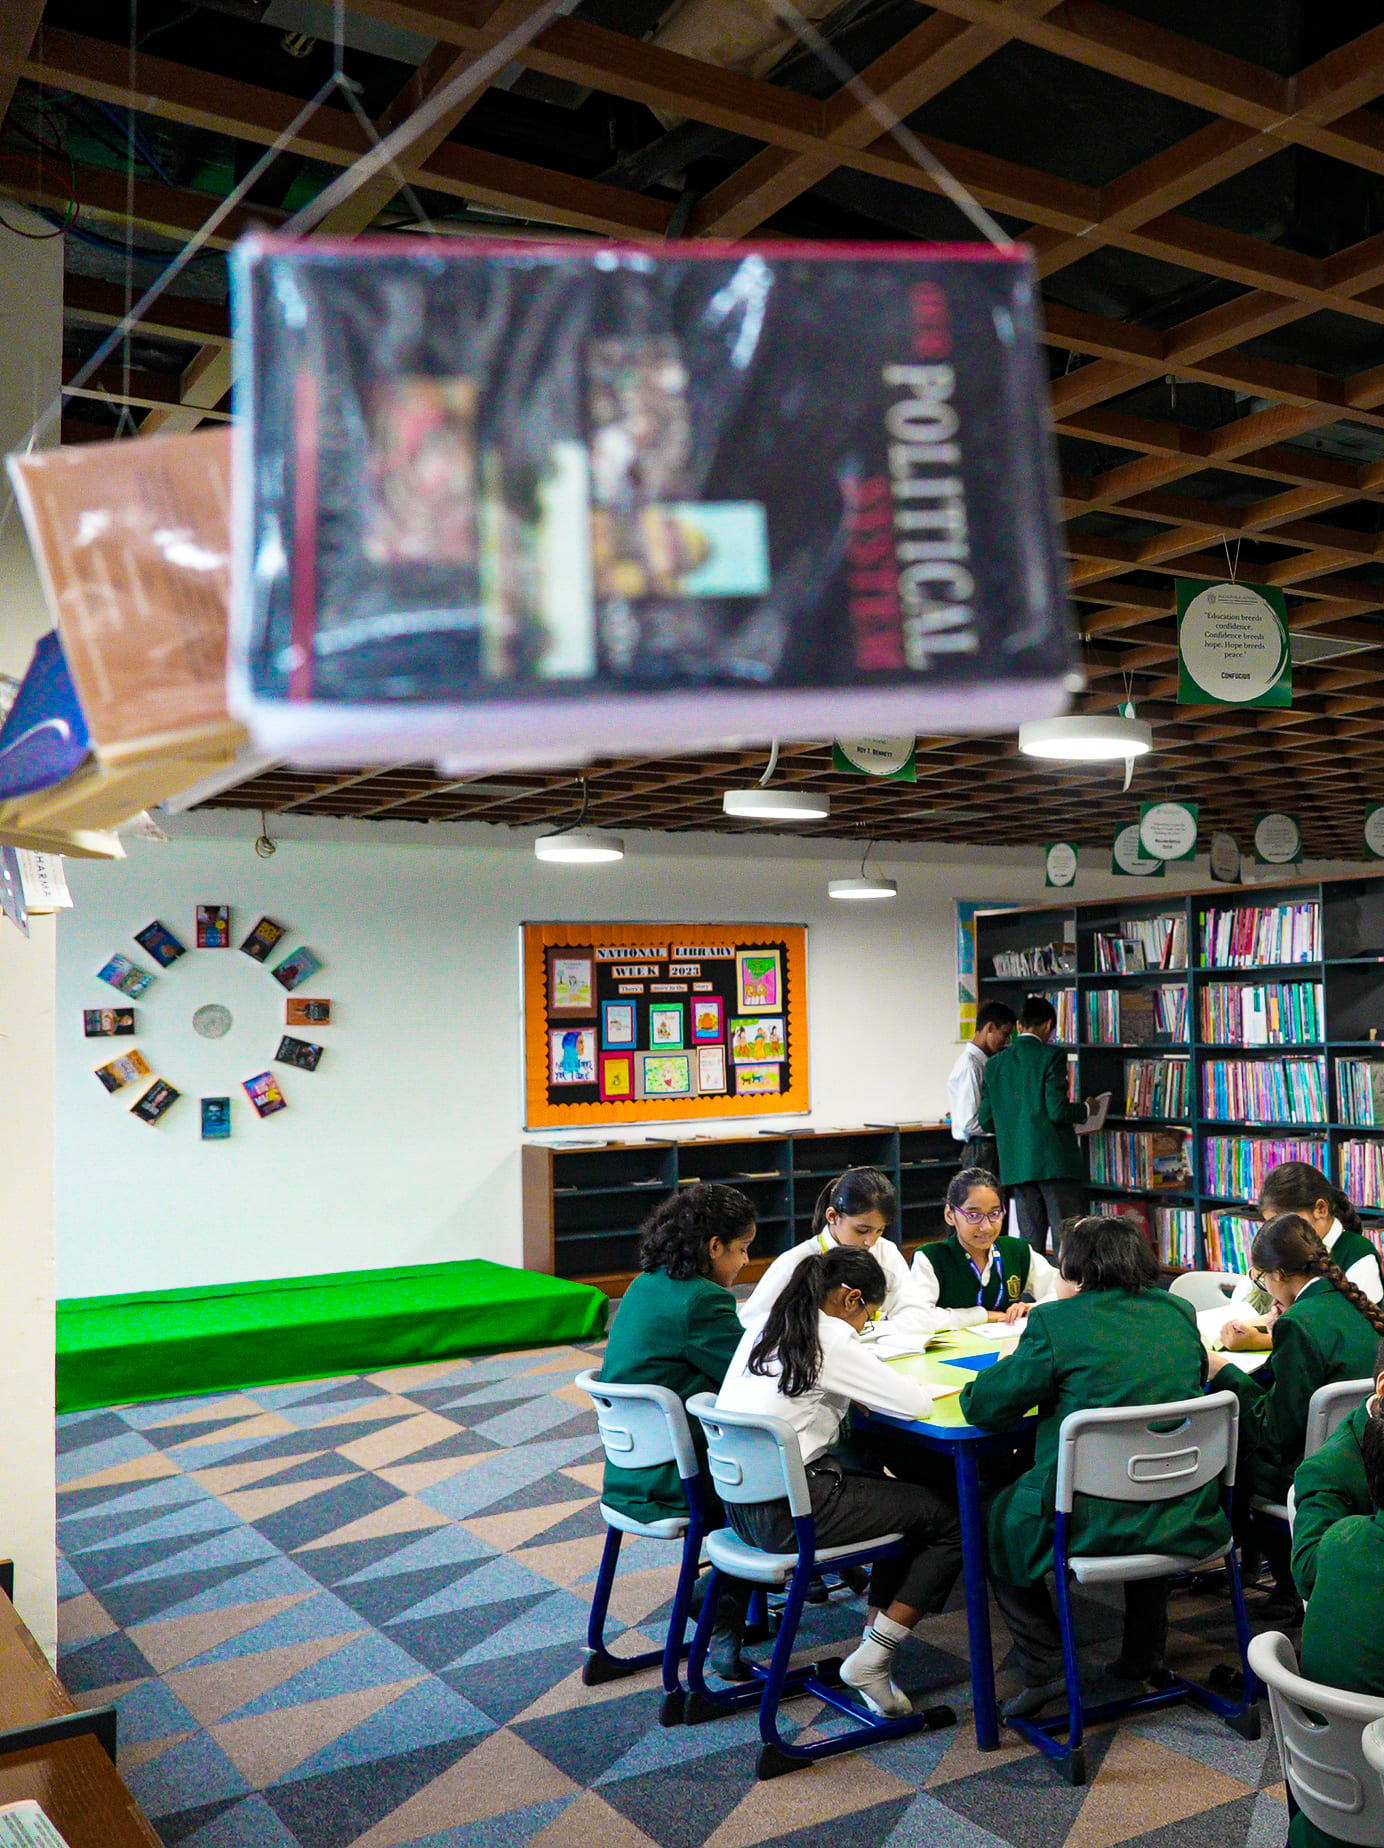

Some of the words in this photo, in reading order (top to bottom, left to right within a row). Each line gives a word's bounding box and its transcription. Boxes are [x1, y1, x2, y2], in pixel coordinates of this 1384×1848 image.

[881, 362, 980, 671] POLITICAL
[597, 948, 664, 959] NATIONAL
[675, 947, 732, 956] LIBRARY
[615, 967, 657, 976] WEEK
[671, 967, 699, 975] 2023
